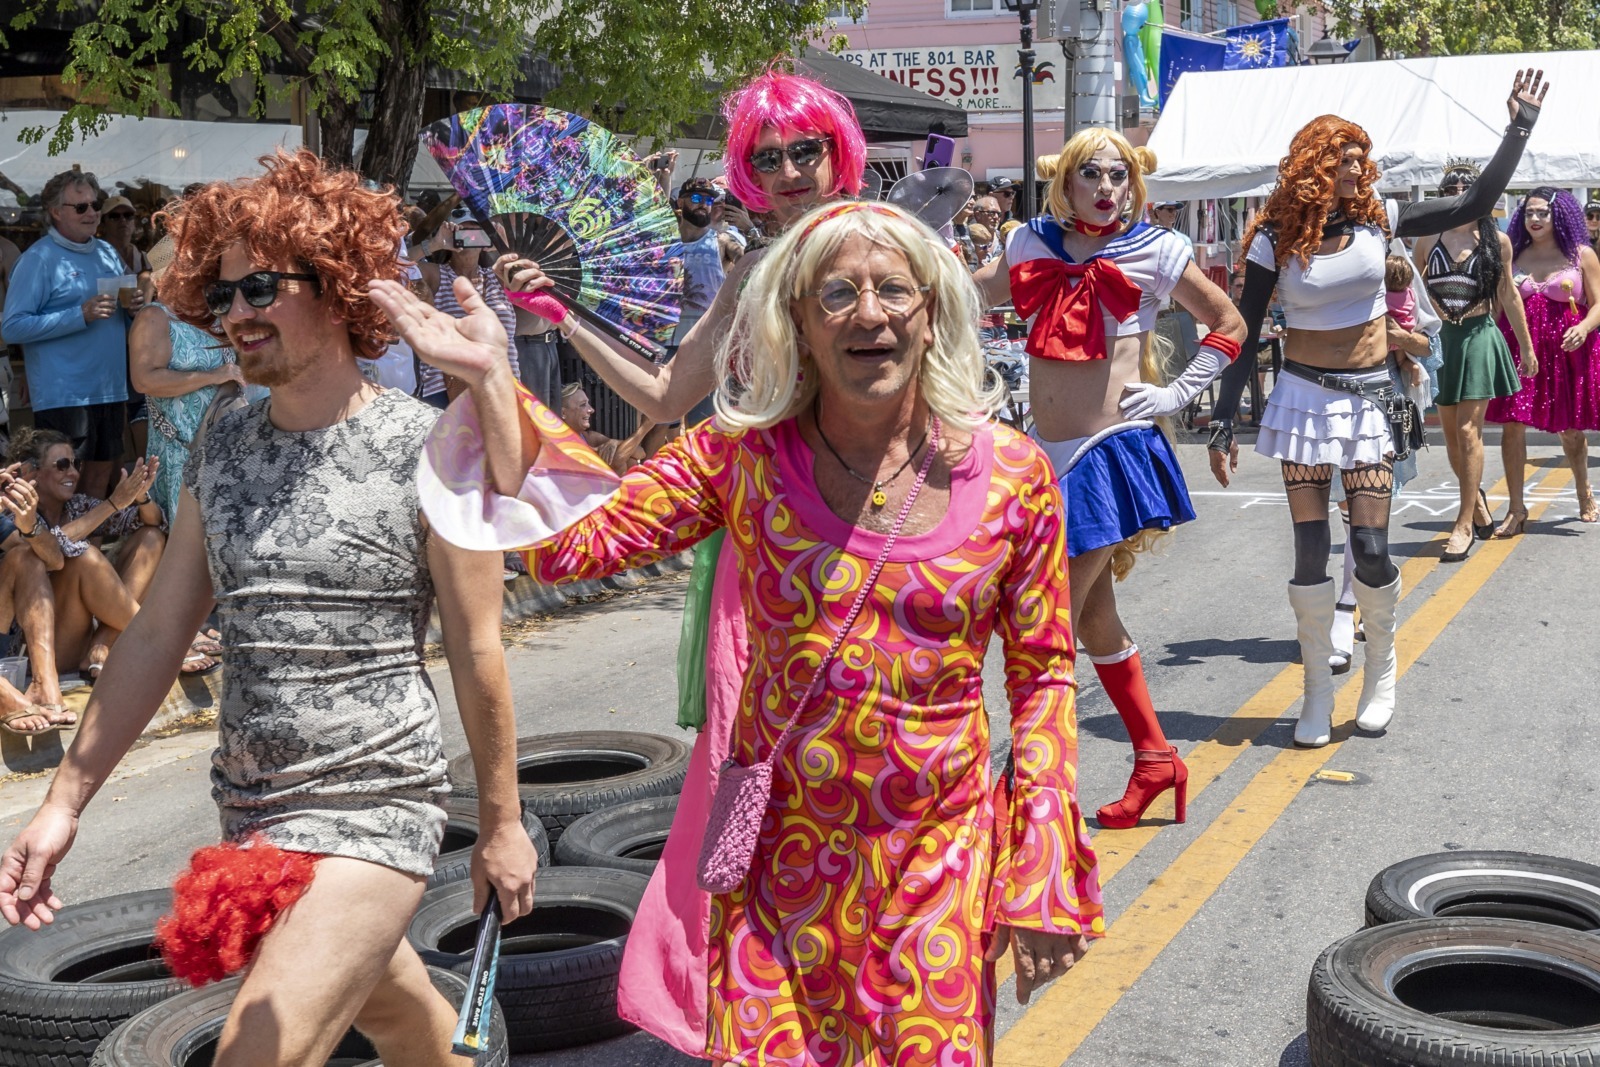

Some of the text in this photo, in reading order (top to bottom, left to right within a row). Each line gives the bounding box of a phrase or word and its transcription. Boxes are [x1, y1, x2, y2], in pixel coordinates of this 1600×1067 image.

[869, 52, 887, 67] AT
[892, 52, 921, 67] THE
[927, 51, 956, 66] 801
[964, 50, 996, 66] BAR
[618, 334, 630, 343] ONE
[629, 339, 642, 350] STOP
[471, 970, 489, 1028] ONE STOP RAVE
